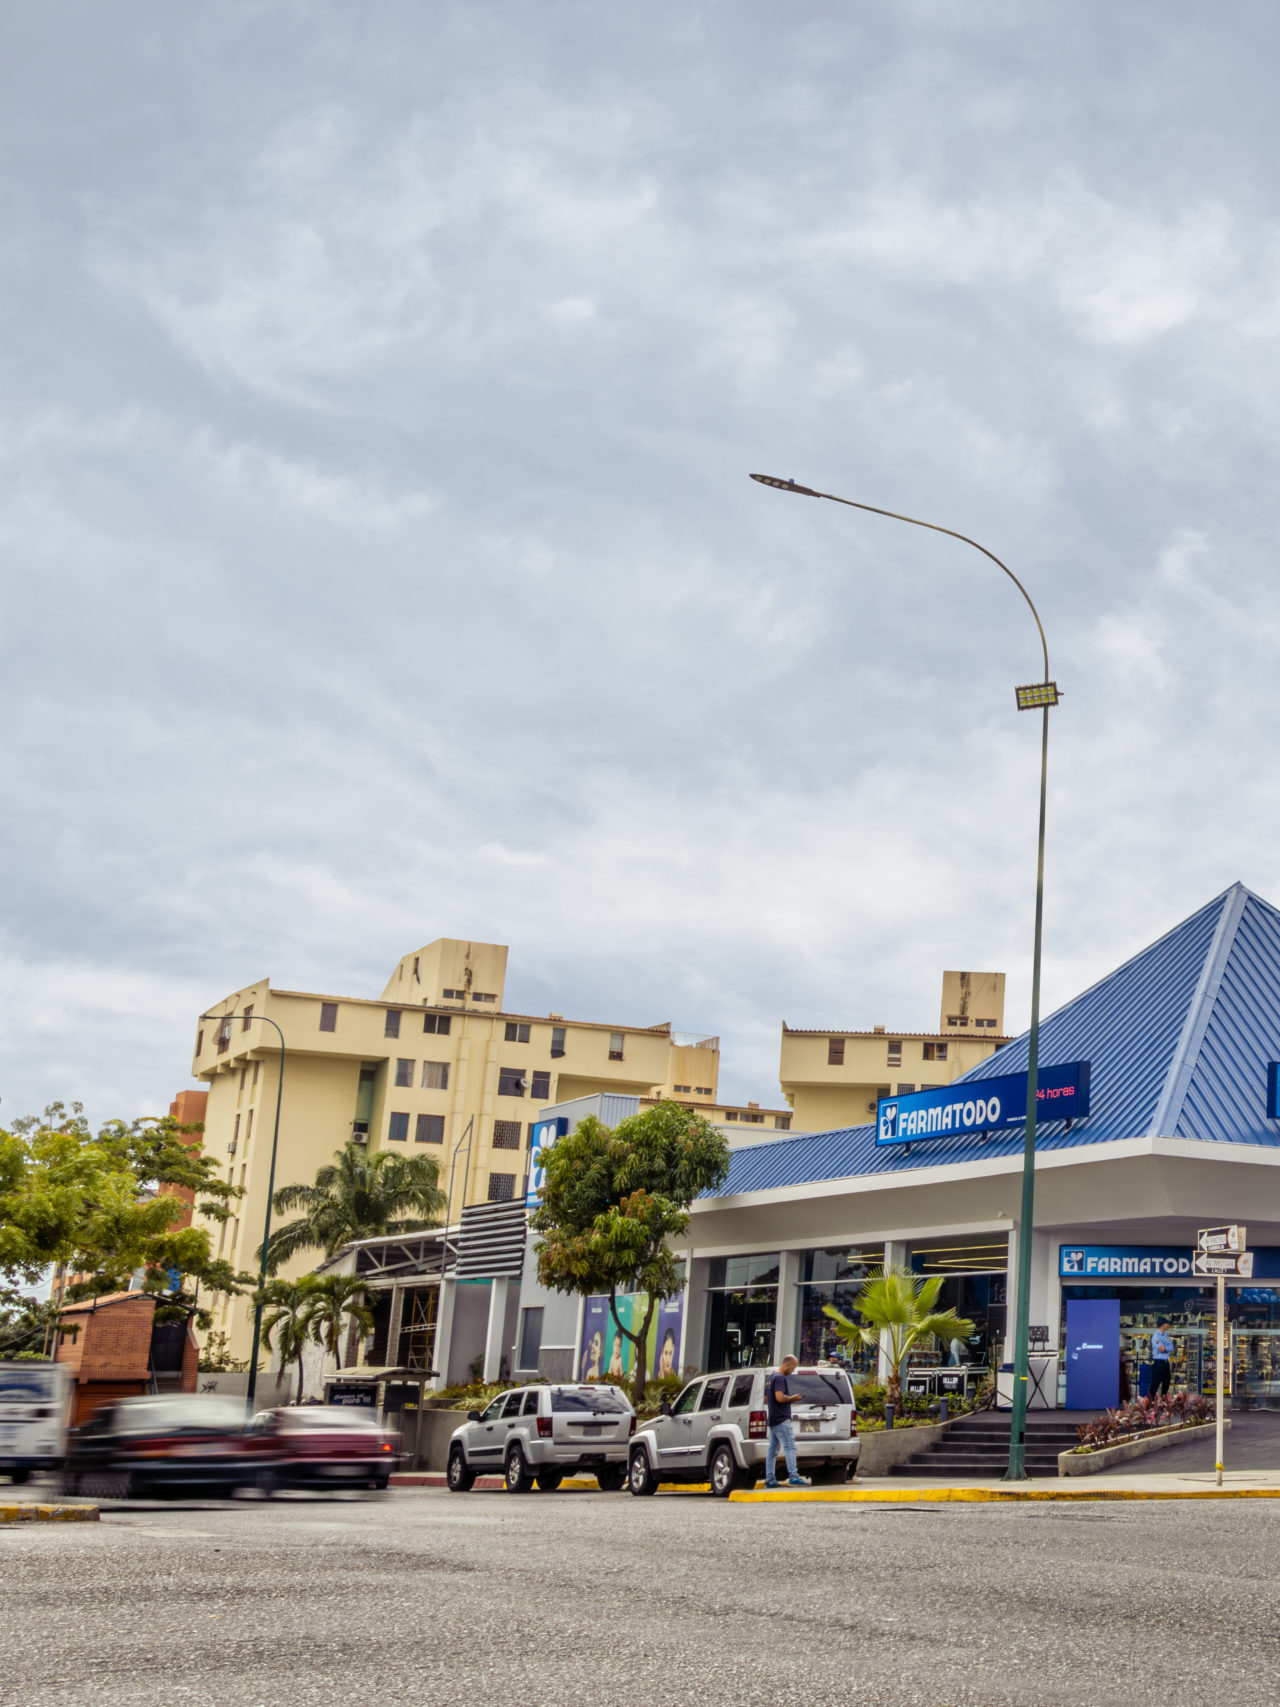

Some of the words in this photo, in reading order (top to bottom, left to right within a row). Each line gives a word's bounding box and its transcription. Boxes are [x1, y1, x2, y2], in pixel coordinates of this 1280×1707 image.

[1047, 1085, 1075, 1100] horas
[898, 1096, 1001, 1137] FARMATODO
[1087, 1256, 1194, 1274] FARMATOD
